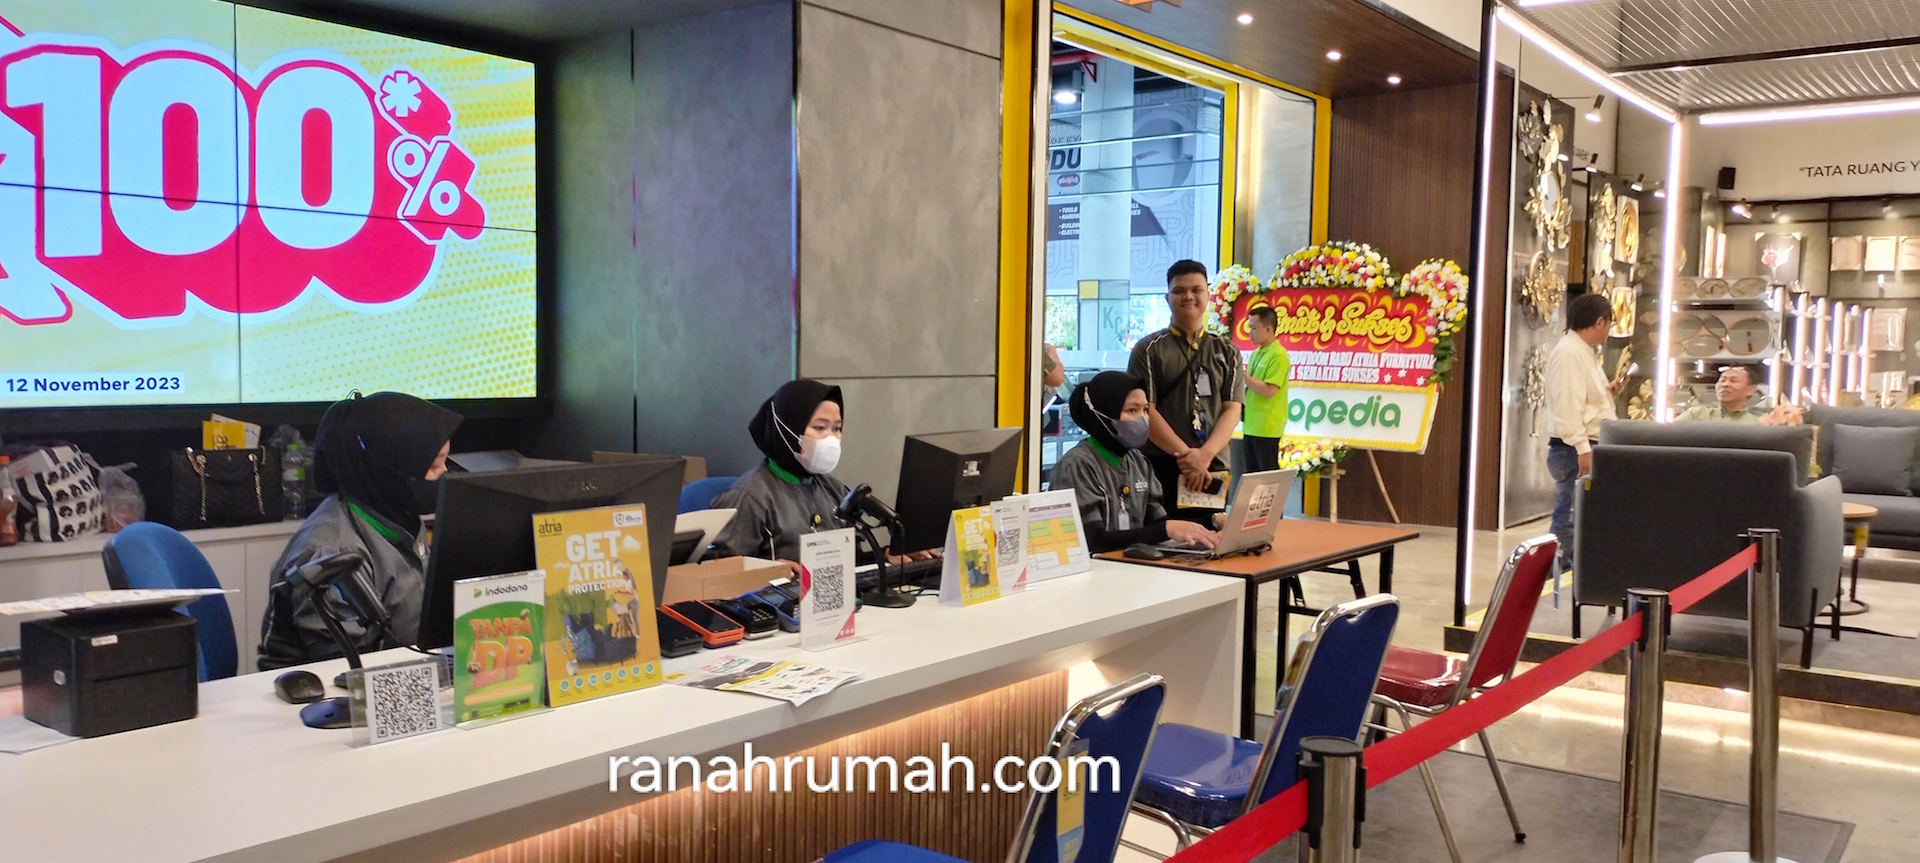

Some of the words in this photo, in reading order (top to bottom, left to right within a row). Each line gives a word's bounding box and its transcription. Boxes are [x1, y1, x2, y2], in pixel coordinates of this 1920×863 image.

[1847, 161, 1906, 176] RUANG
[1341, 367, 1380, 383] SUKSES
[6, 378, 28, 392] 12
[34, 377, 130, 392] November
[135, 377, 180, 390] 2023
[538, 518, 562, 534] atria
[963, 518, 984, 535] GET
[566, 530, 622, 563] GET
[569, 559, 624, 583] ATRIA
[469, 615, 533, 640] TANPA
[472, 636, 533, 689] DP
